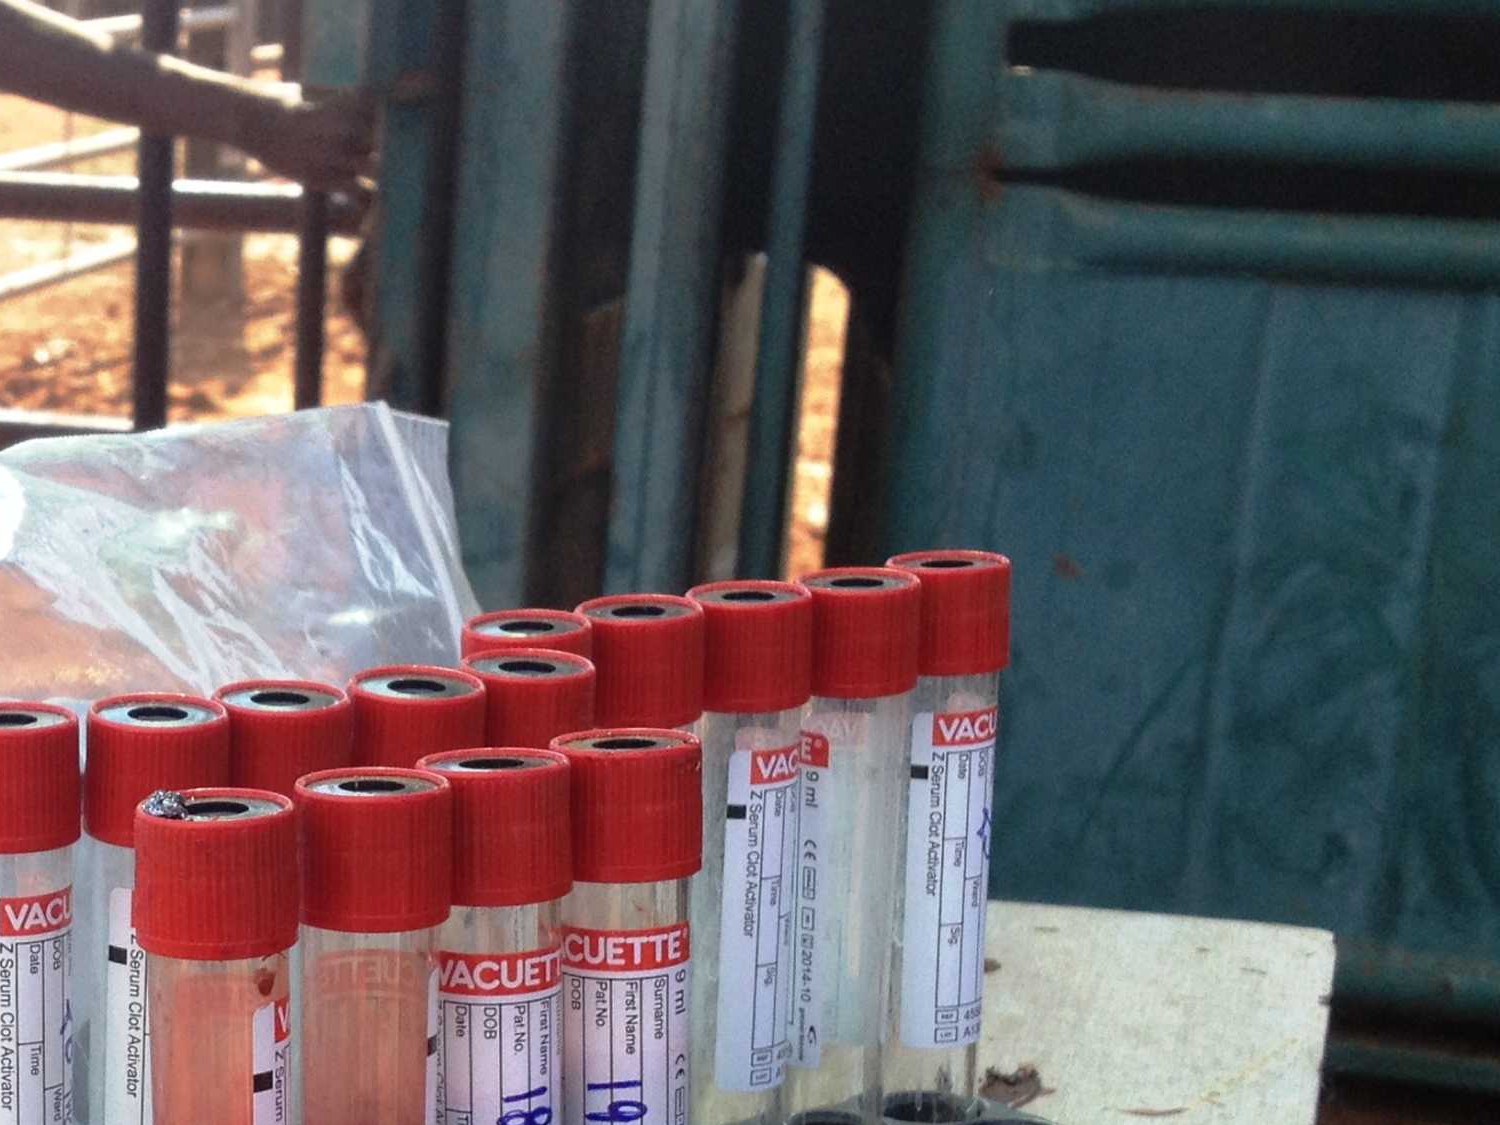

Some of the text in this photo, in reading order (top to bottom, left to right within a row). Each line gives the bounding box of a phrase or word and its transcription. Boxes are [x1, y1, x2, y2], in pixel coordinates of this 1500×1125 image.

[930, 765, 944, 808] Serum
[748, 803, 762, 848] Serum
[929, 811, 942, 838] Clot
[745, 850, 760, 878] Clot
[926, 840, 941, 897] Activator
[743, 881, 758, 938] Activator
[29, 943, 41, 975] Date
[561, 928, 682, 966] CUETTE
[128, 949, 144, 998] Serum
[570, 978, 581, 1011] DOB
[675, 968, 687, 1015] 9 ml
[0, 943, 15, 1112] Z Serum Clot Activator
[127, 1001, 143, 1031] Clot
[455, 1005, 468, 1038] Date
[483, 1006, 498, 1041] DOB
[625, 981, 639, 1055] First Name
[654, 978, 666, 1040] Surname
[539, 1000, 550, 1075] First Name
[30, 1044, 42, 1077] Time
[126, 1033, 142, 1099] Activator
[274, 1065, 285, 1122] Serum
[584, 1079, 648, 1124] 19
